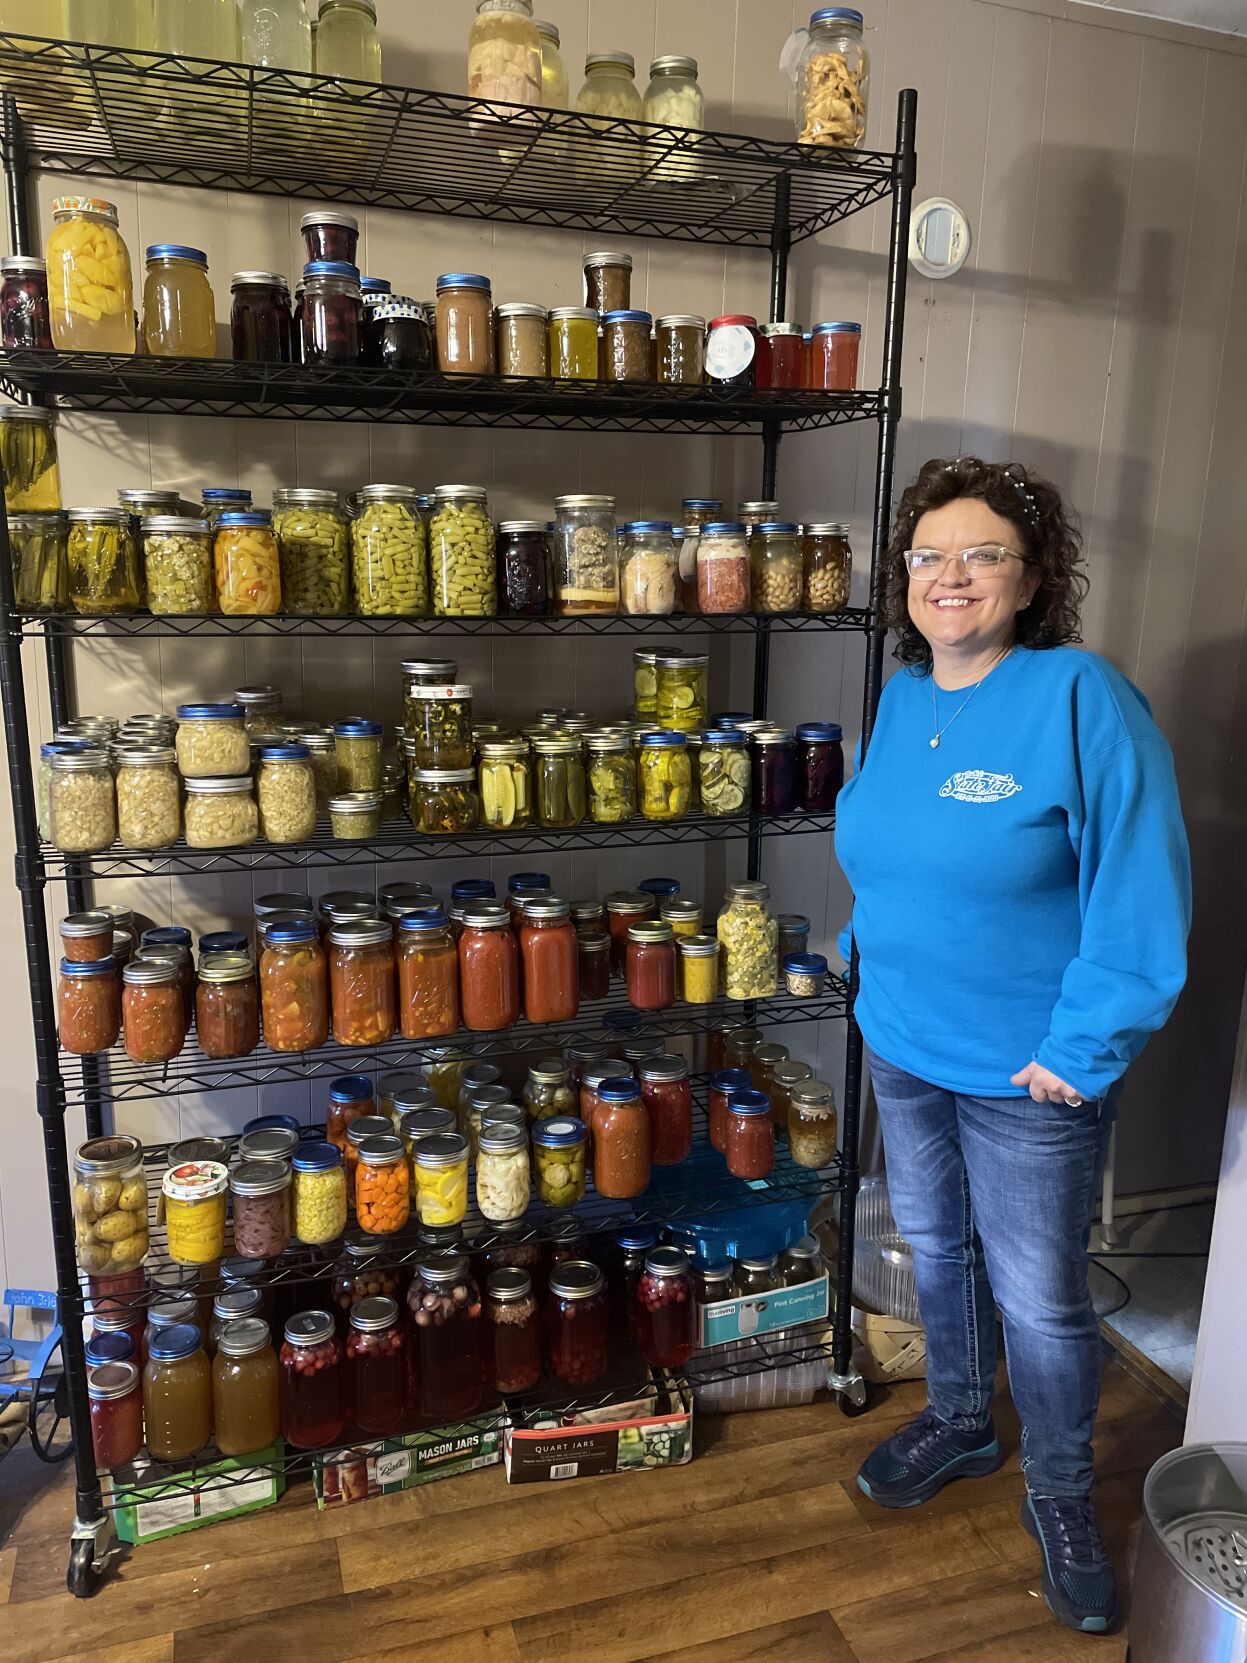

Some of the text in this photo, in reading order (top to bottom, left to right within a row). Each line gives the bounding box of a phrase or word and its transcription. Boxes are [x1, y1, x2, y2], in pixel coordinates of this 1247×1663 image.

[418, 1443, 453, 1461] MASON
[455, 1435, 479, 1451] JARS
[535, 1440, 594, 1453] QUART JARS
[380, 1457, 406, 1476] Ball
